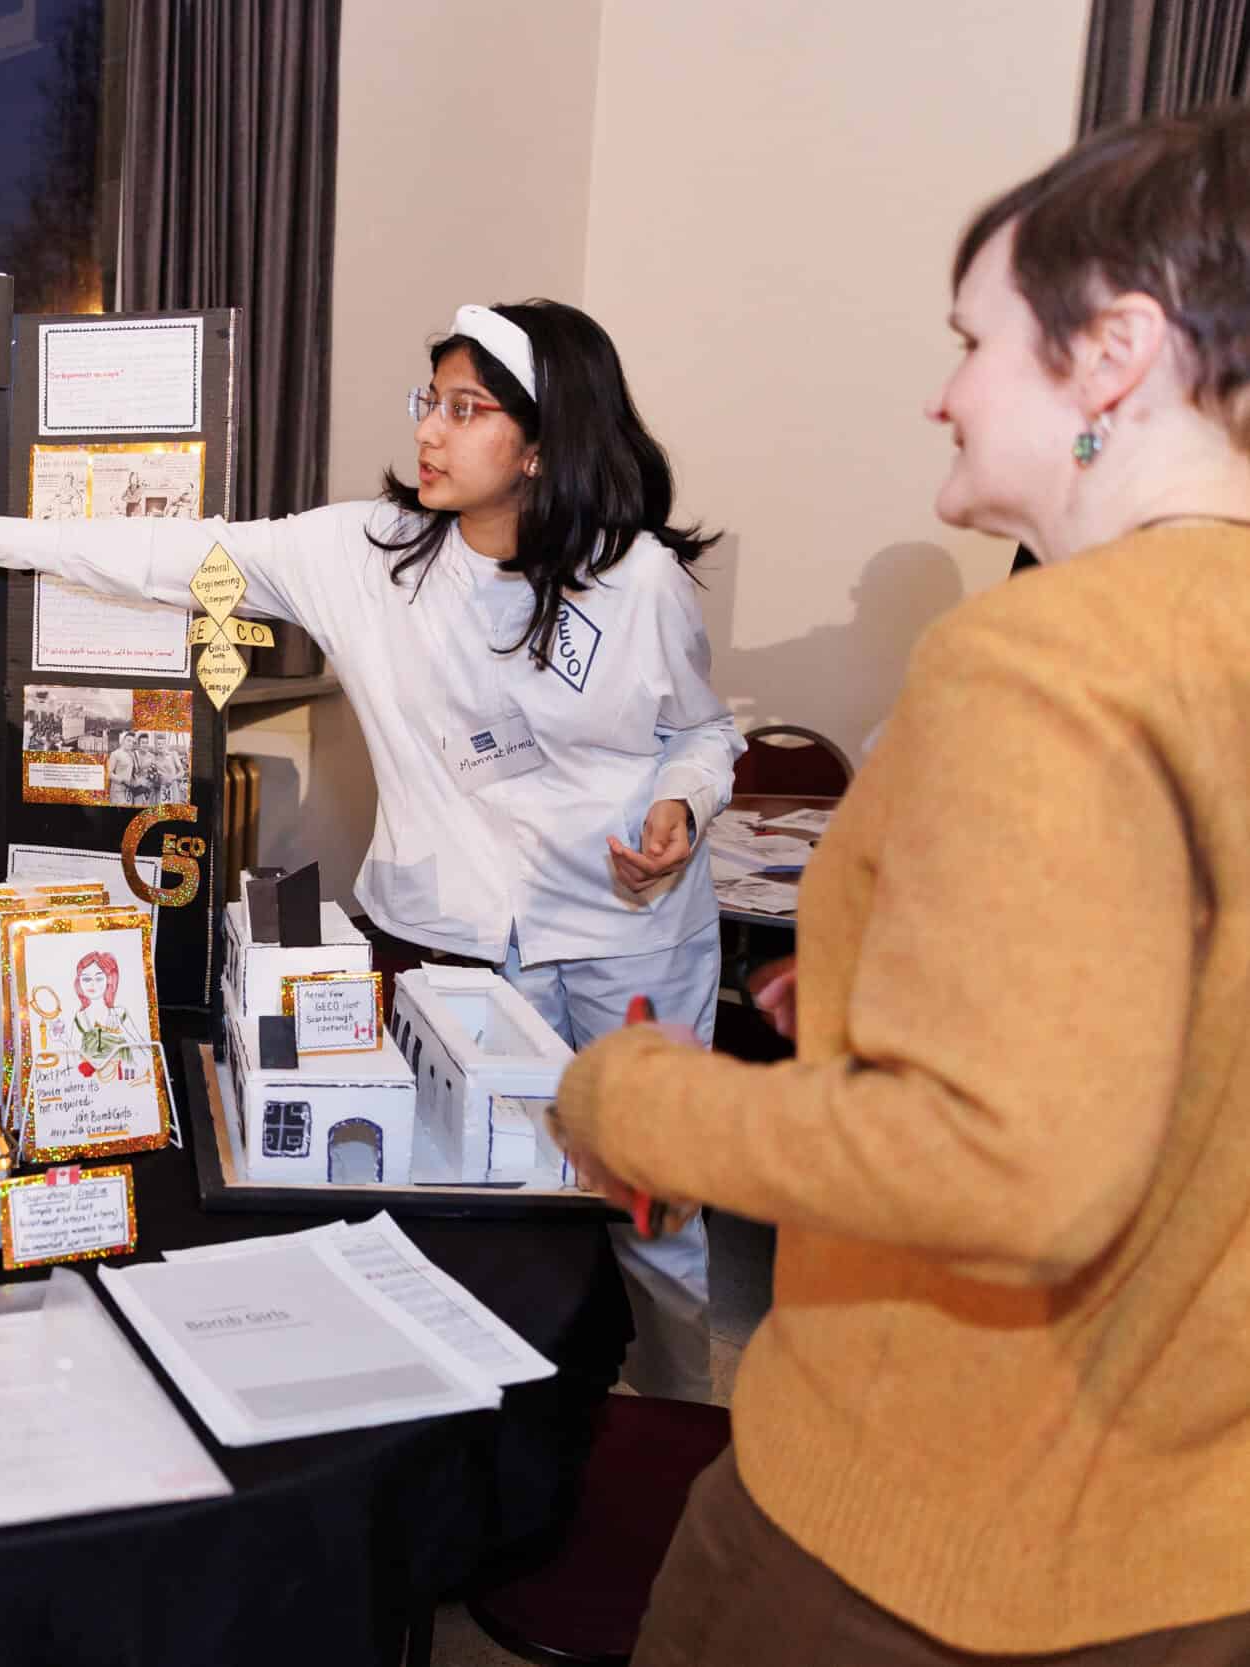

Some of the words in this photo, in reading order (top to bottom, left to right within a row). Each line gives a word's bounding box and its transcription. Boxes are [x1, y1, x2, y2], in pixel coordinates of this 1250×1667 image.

[196, 577, 240, 593] Engineering
[459, 748, 505, 771] Mannat
[505, 739, 535, 755] Verma
[183, 1314, 243, 1330] Bomb
[245, 1309, 291, 1324] Girls
